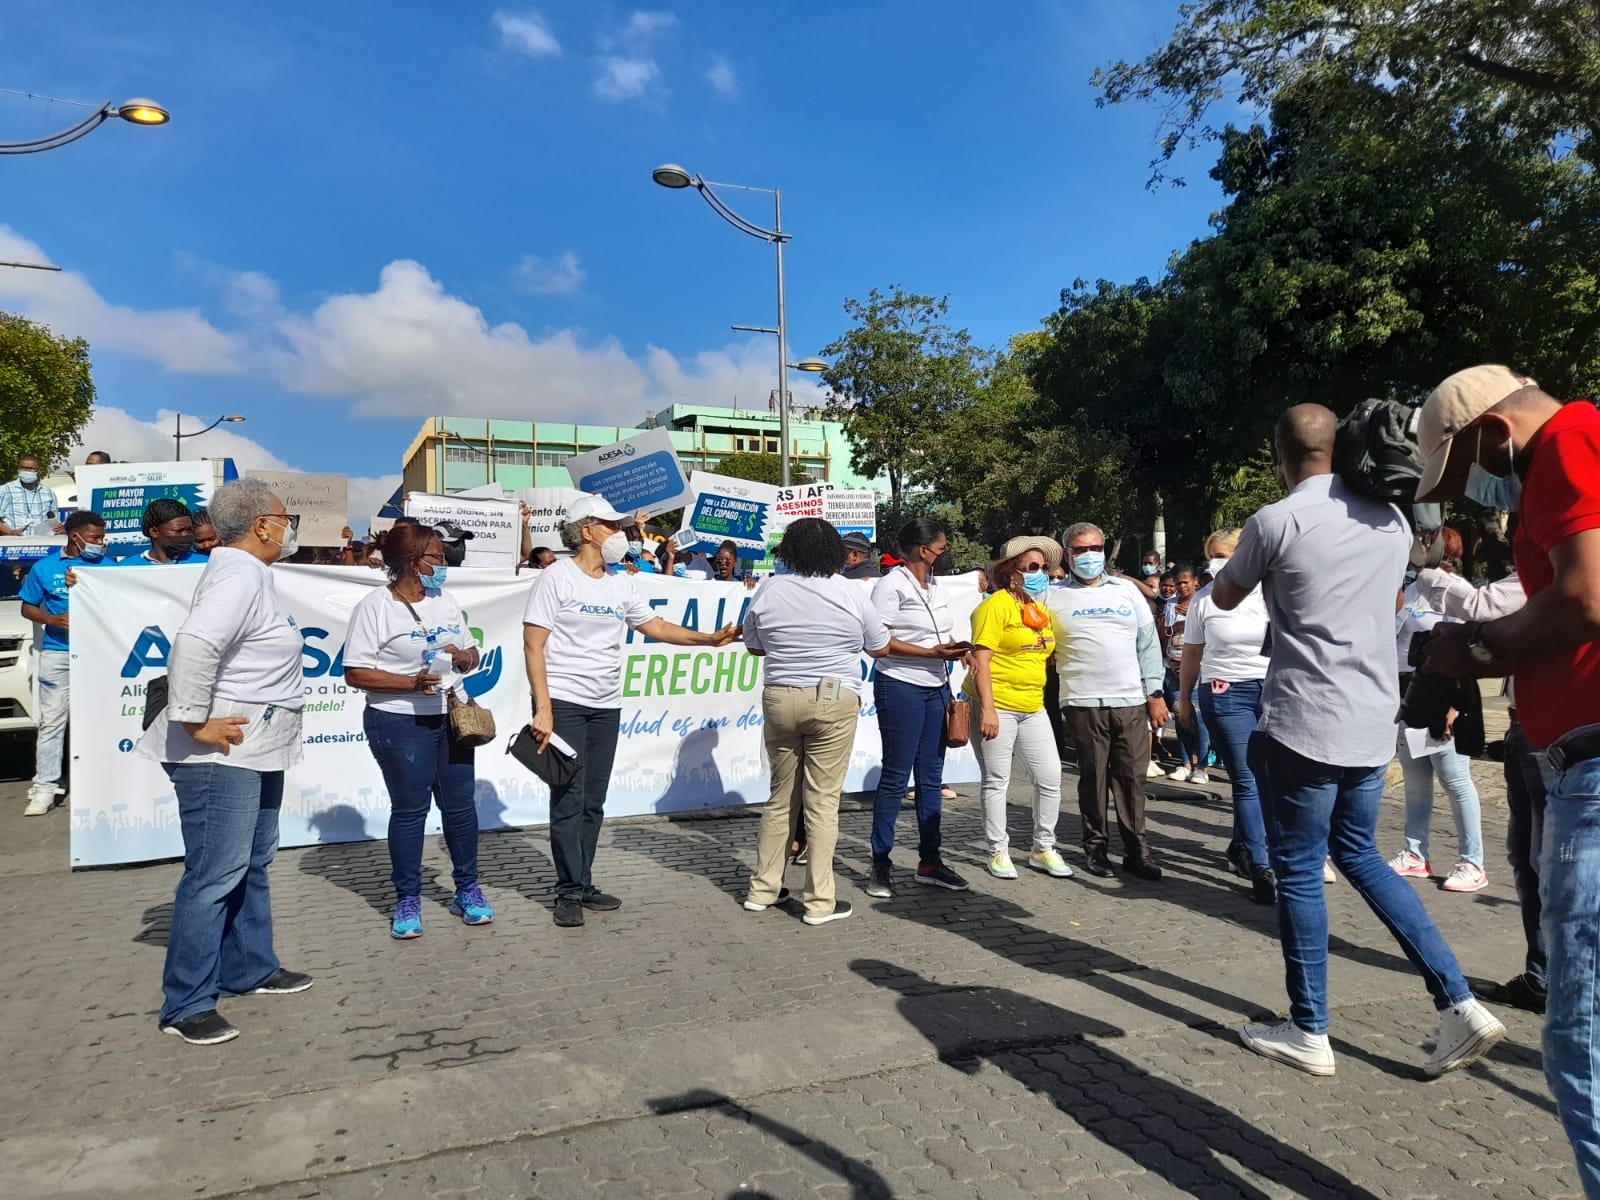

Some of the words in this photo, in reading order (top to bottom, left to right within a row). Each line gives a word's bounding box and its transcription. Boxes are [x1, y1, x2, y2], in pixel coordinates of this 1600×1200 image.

[598, 449, 624, 462] ADESA
[104, 490, 118, 498] POR
[118, 488, 145, 498] MAYOR
[776, 490, 794, 502] RS
[102, 498, 143, 508] INVERSIÓN
[720, 498, 760, 513] ELIMINACIÓN
[776, 499, 824, 511] ASESINOS
[828, 501, 845, 509] TIENEN
[846, 501, 854, 509] LOS
[102, 511, 129, 519] CALIDAD
[555, 505, 567, 516] de
[701, 506, 713, 516] DEL
[714, 508, 739, 521] COPAGO
[826, 511, 850, 519] DERECHOS
[861, 511, 874, 519] SALUD
[113, 519, 141, 529] SALUD.
[489, 520, 512, 529] PARA
[473, 531, 497, 539] ODAS
[579, 604, 615, 614] ADESA
[1072, 607, 1115, 616] ADESA
[622, 651, 760, 698] ERECHO
[318, 686, 328, 695] a
[333, 683, 347, 694] la
[121, 703, 137, 717] La
[302, 700, 345, 712] endelo!
[618, 709, 669, 739] alud
[672, 716, 694, 737] es
[700, 715, 731, 731] un
[303, 731, 366, 744] .adesaird
